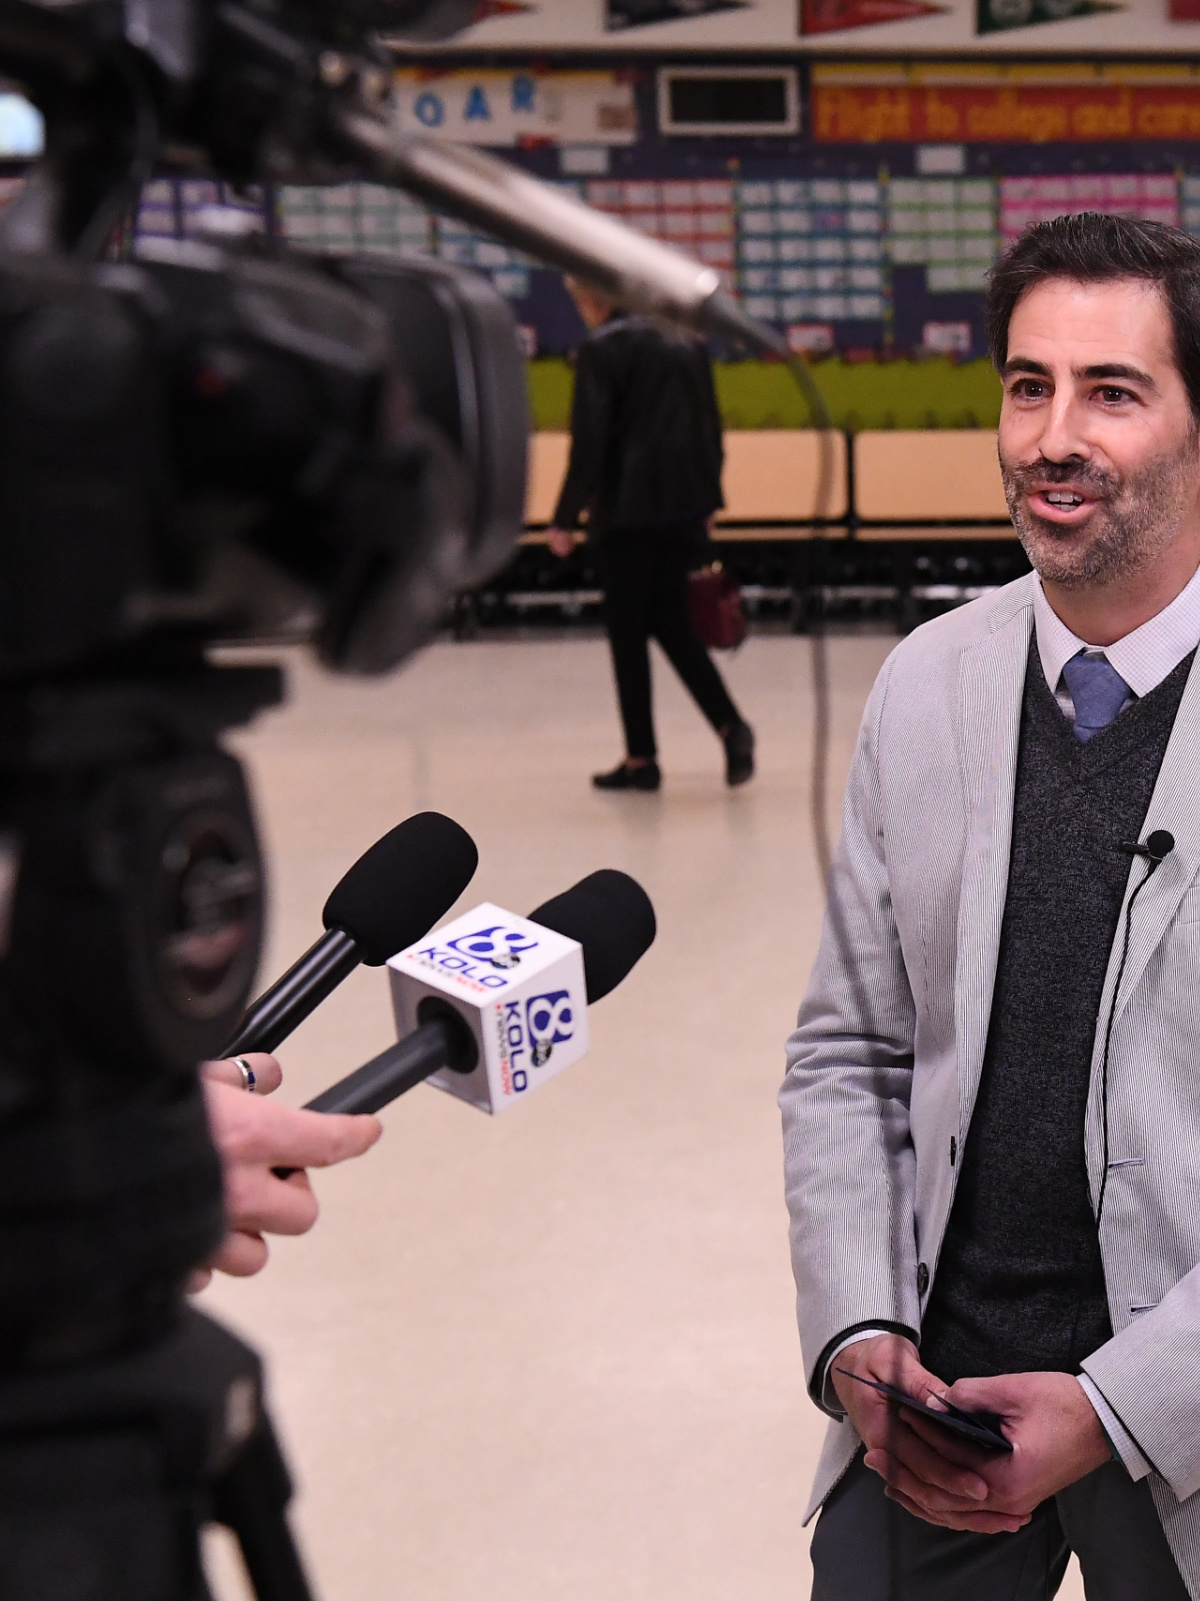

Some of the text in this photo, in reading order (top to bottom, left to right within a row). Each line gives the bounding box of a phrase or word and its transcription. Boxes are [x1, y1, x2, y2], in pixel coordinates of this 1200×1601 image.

[417, 947, 508, 988] KOLO
[446, 926, 538, 963] 8
[526, 990, 573, 1048] 8
[504, 1001, 528, 1092] KOLO
